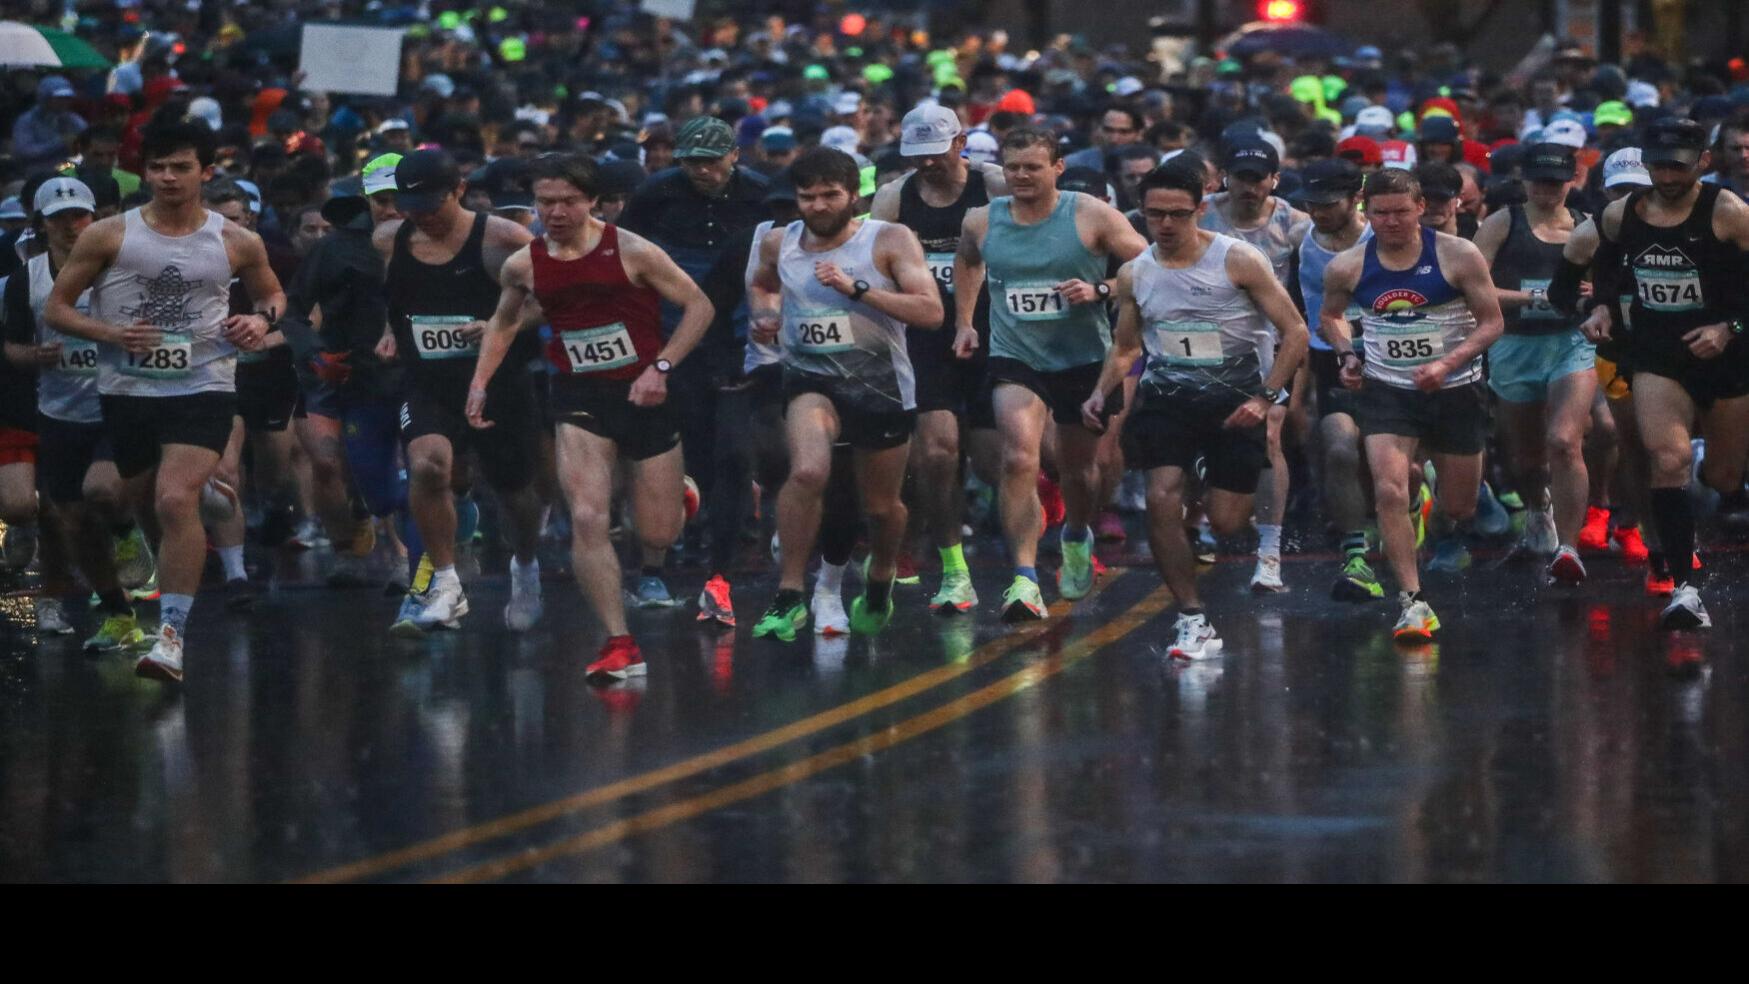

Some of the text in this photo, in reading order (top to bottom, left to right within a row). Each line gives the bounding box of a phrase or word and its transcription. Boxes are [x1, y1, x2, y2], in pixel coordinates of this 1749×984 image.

[1009, 291, 1062, 313] 1571
[1376, 291, 1409, 310] BOULDER
[1640, 283, 1699, 304] 1674
[421, 329, 467, 350] 609
[800, 322, 841, 345] 264
[570, 337, 628, 365] 1451
[1179, 337, 1192, 357] 1
[1386, 337, 1433, 359] 835
